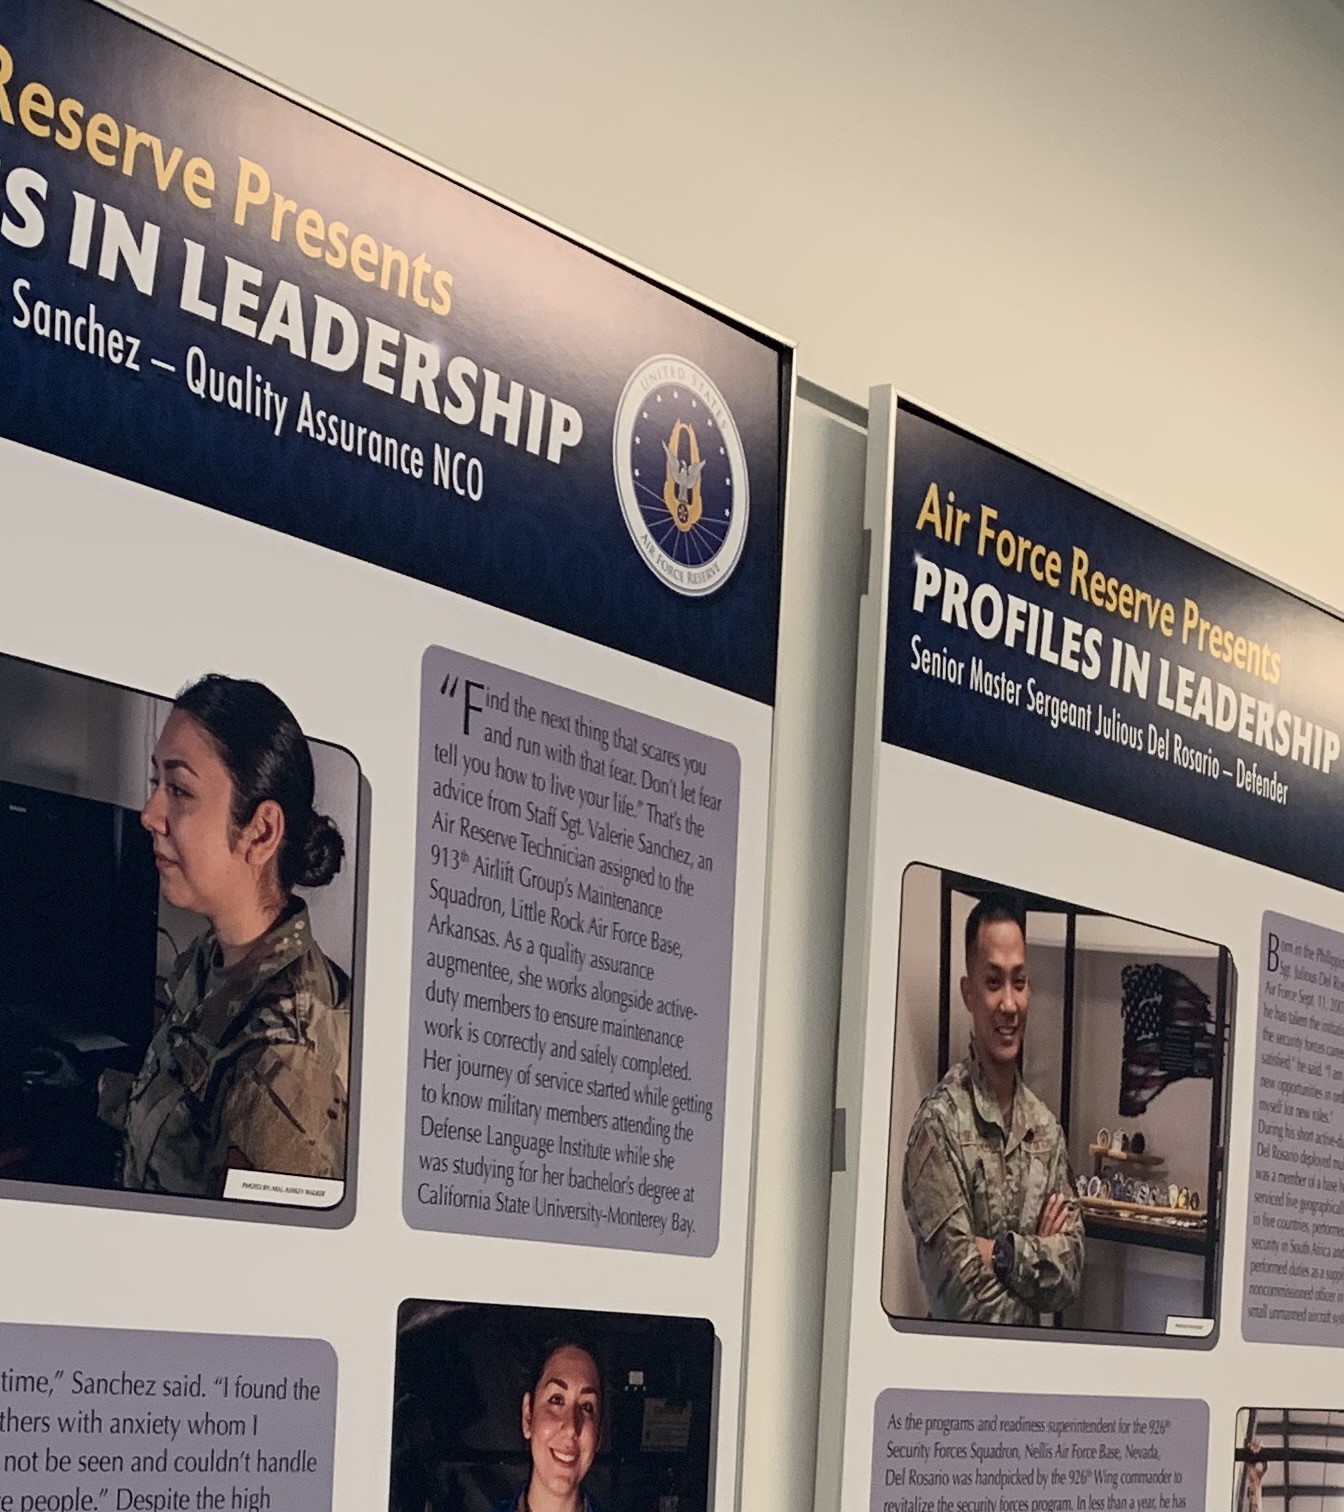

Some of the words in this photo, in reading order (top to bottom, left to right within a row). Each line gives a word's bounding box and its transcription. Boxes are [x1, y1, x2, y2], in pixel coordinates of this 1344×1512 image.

[234, 157, 455, 317] Presents
[69, 192, 159, 295] IN
[182, 243, 581, 462] LEADERSHIP
[13, 279, 140, 371] Sanchez
[186, 346, 288, 436] Quality
[297, 392, 424, 478] Assurance
[433, 443, 483, 501] NCO
[640, 365, 685, 391] UNITED
[691, 373, 727, 430] STATES
[641, 534, 655, 556] AIR
[656, 554, 684, 583] FORCE
[916, 482, 971, 546] Air
[978, 505, 1062, 587] Force
[1070, 547, 1175, 636] Reserve
[1181, 598, 1281, 685] Presents
[910, 634, 965, 685] Senior
[969, 656, 1022, 706] Master
[1026, 677, 1092, 732] Sergeant
[1094, 704, 1143, 751] Julious
[1147, 723, 1170, 761] Del
[1173, 734, 1220, 779] Rosario
[1236, 758, 1288, 805] Defender
[914, 555, 1102, 679] PROFILES
[1110, 638, 1151, 699] IN
[1158, 659, 1337, 773] LEADERSHIP
[431, 810, 456, 834] Air
[460, 816, 518, 851] Reserve
[520, 832, 596, 871] Technician
[599, 859, 656, 887] assigned
[658, 872, 672, 891] to
[674, 873, 695, 897] the
[429, 878, 505, 917] Squadron,
[511, 897, 546, 925] Little
[550, 906, 585, 933] Rock
[587, 917, 609, 938] Air
[612, 921, 648, 948] Force
[650, 930, 683, 960] Base,
[417, 1182, 491, 1211] California
[495, 1191, 531, 1215] State
[535, 1197, 668, 1235] University-Monterey
[671, 1212, 696, 1238] Bay.
[57, 1408, 103, 1434] with
[109, 1412, 181, 1442] anxiety
[187, 1411, 246, 1436] whom
[252, 1414, 258, 1436] I
